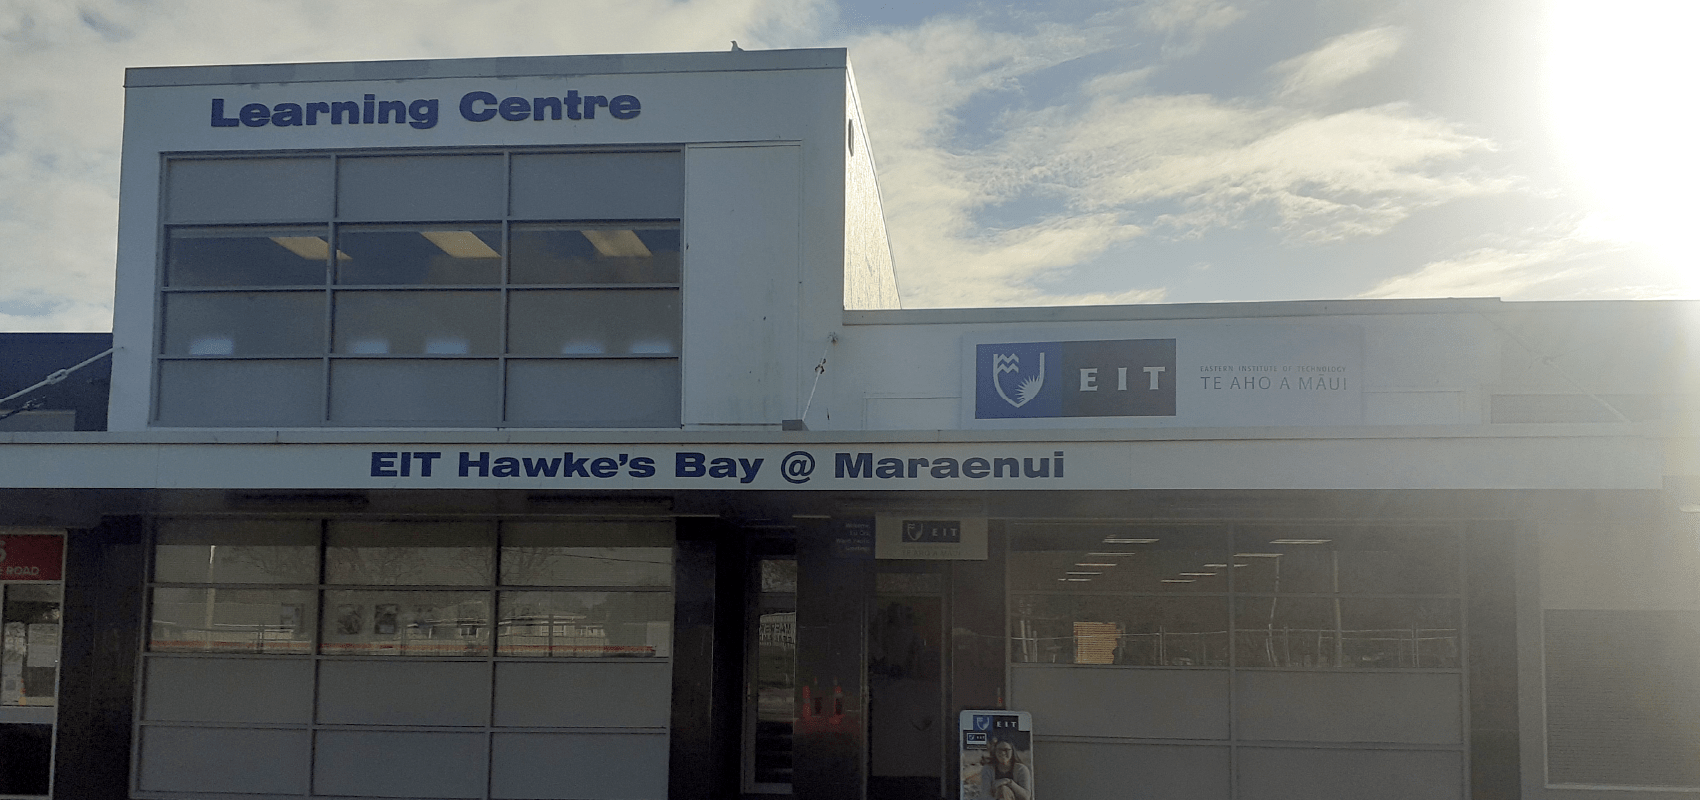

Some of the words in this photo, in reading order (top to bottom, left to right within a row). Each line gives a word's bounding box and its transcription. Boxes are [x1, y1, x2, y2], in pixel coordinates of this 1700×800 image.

[210, 93, 439, 130] Learning
[458, 90, 642, 123] Centre
[1297, 365, 1347, 373] TECHNOLOGY
[1079, 365, 1166, 392] EIT
[1200, 376, 1222, 390] TE
[1230, 376, 1271, 390] AHO
[1280, 376, 1291, 390] A
[1299, 374, 1347, 391] MĀUI
[370, 451, 442, 478] EIT
[674, 451, 765, 484] Bay
[780, 450, 816, 485] @
[834, 450, 1066, 479] Maraenui
[932, 528, 958, 537] EIT
[6, 565, 40, 576] ROAD
